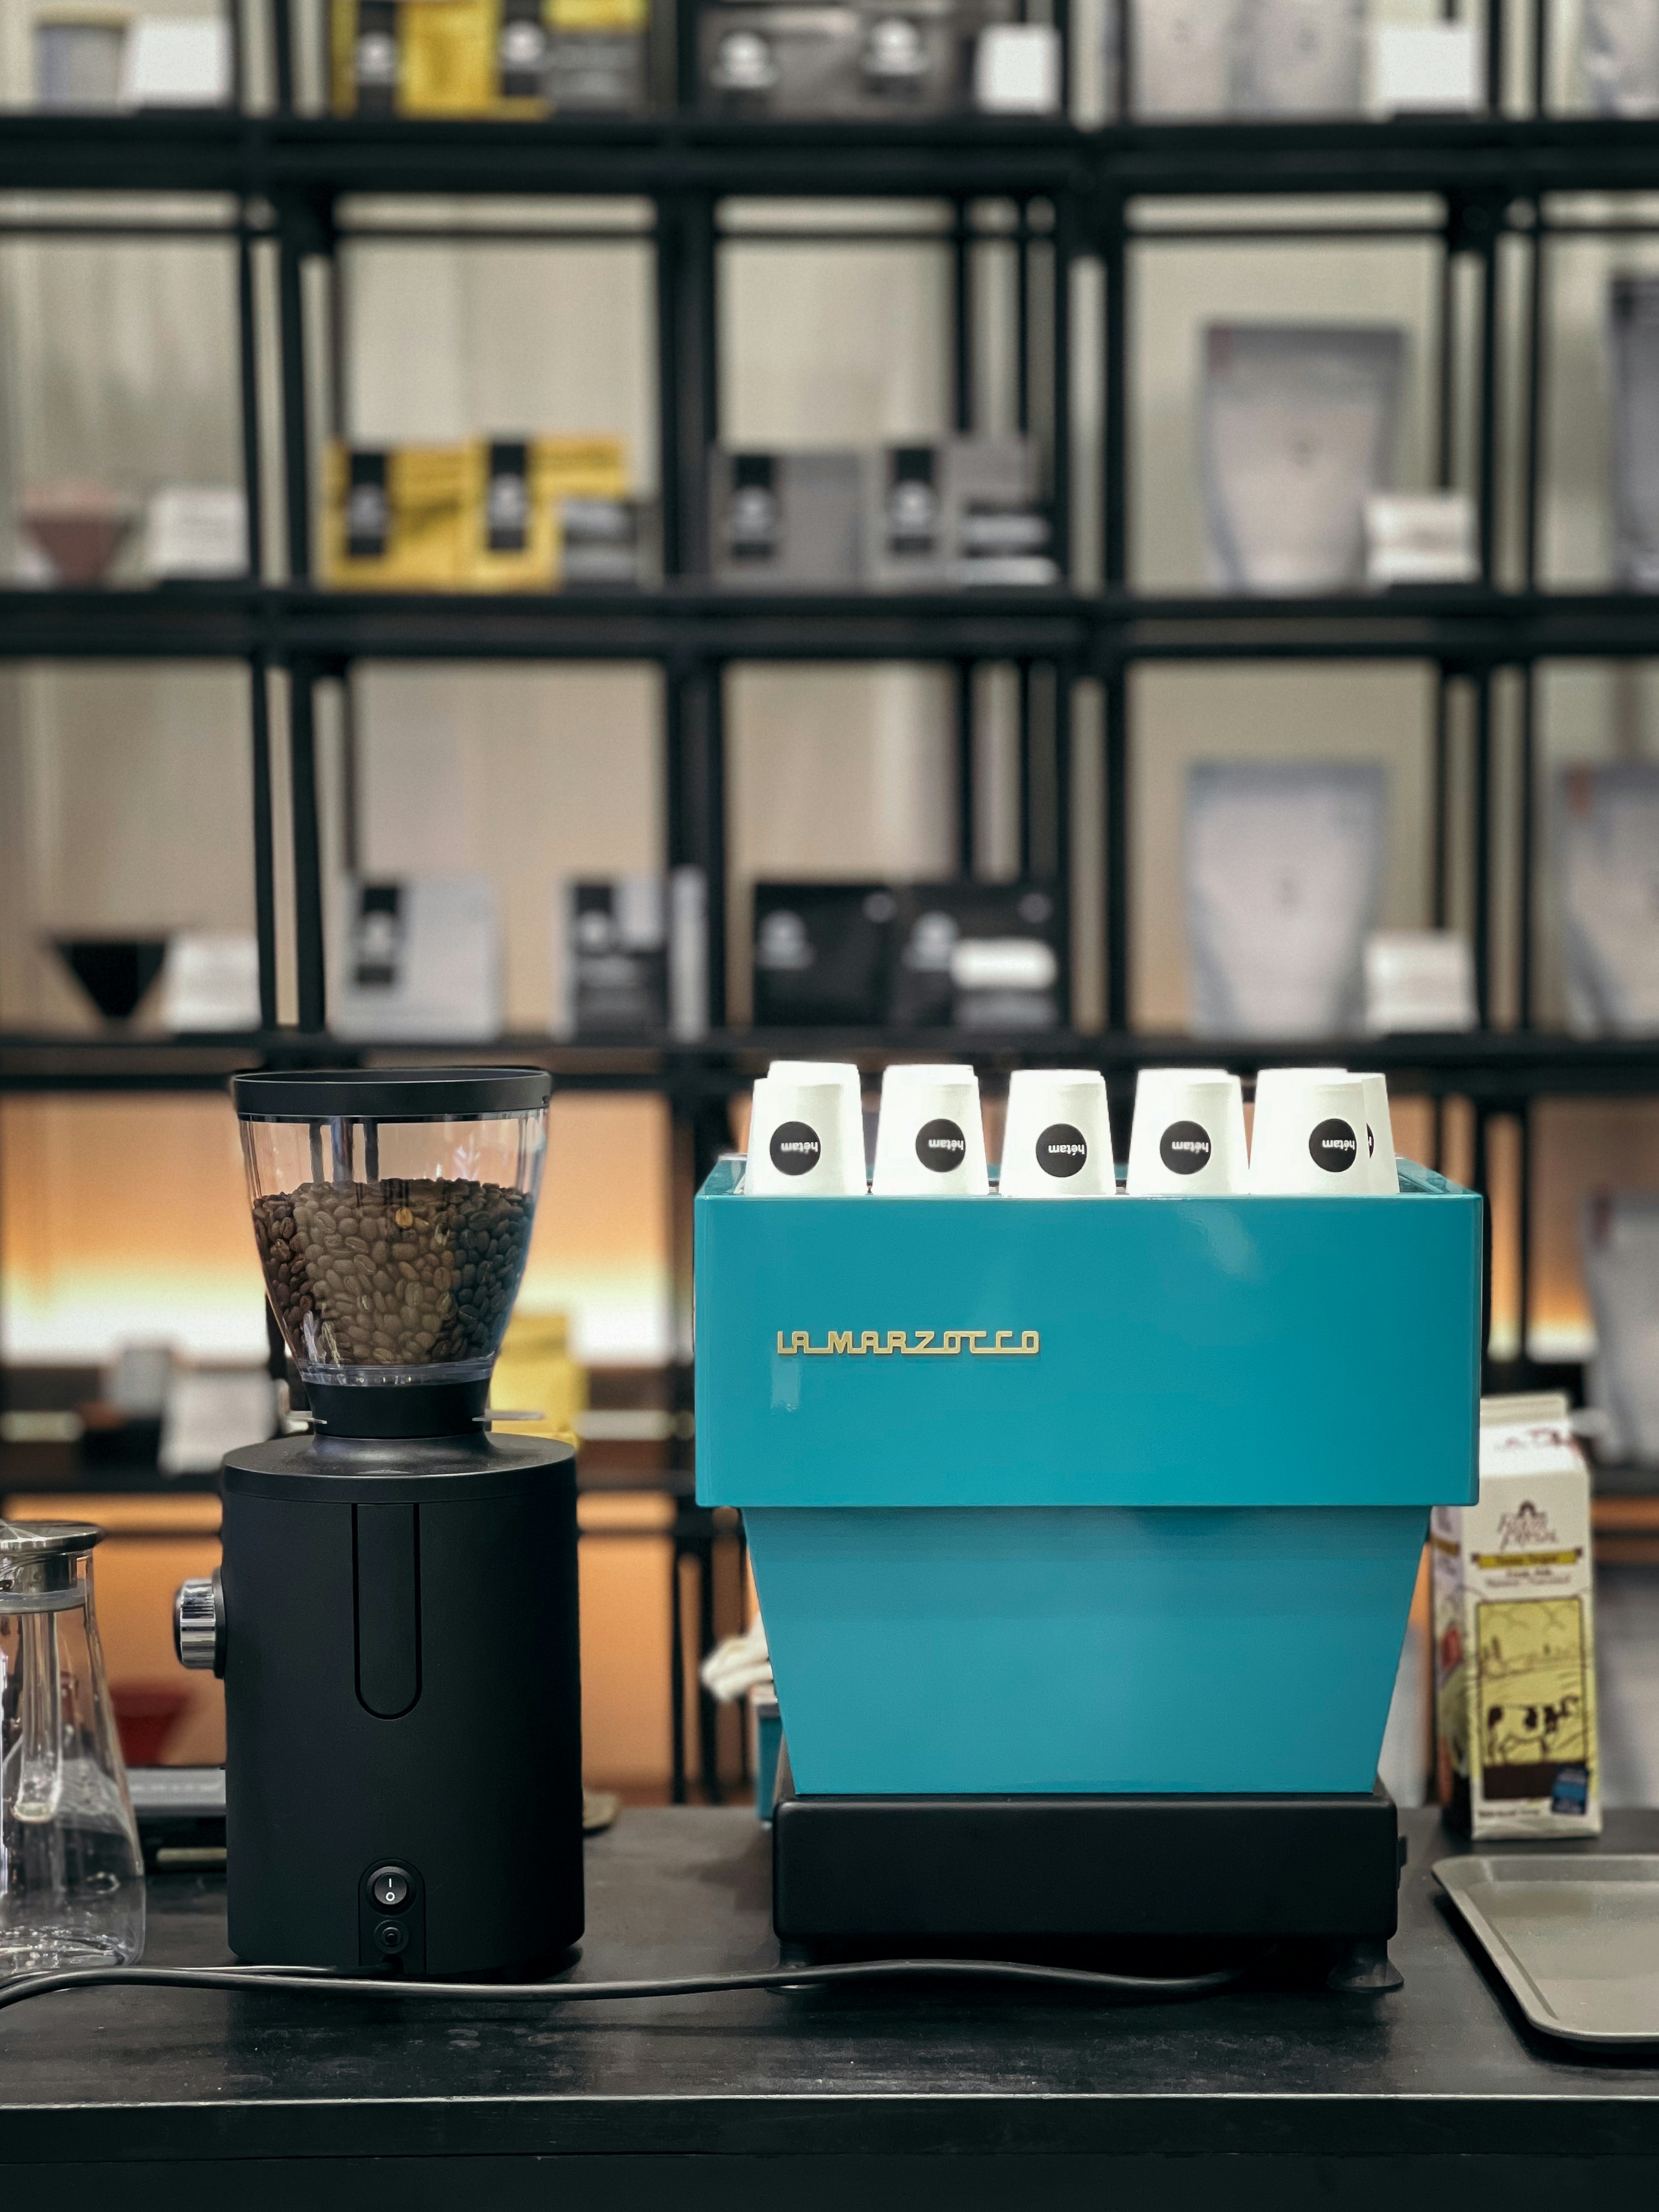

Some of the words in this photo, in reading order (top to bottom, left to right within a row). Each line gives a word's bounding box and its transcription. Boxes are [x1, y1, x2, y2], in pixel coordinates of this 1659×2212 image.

[780, 1142, 819, 1154] hétam
[928, 1139, 964, 1152] hétam
[1048, 1144, 1085, 1156] hétam
[1171, 1141, 1209, 1154] hétam
[1322, 1139, 1355, 1151] hétam
[777, 1330, 809, 1354] LA
[828, 1330, 1039, 1354] MARZOCCO
